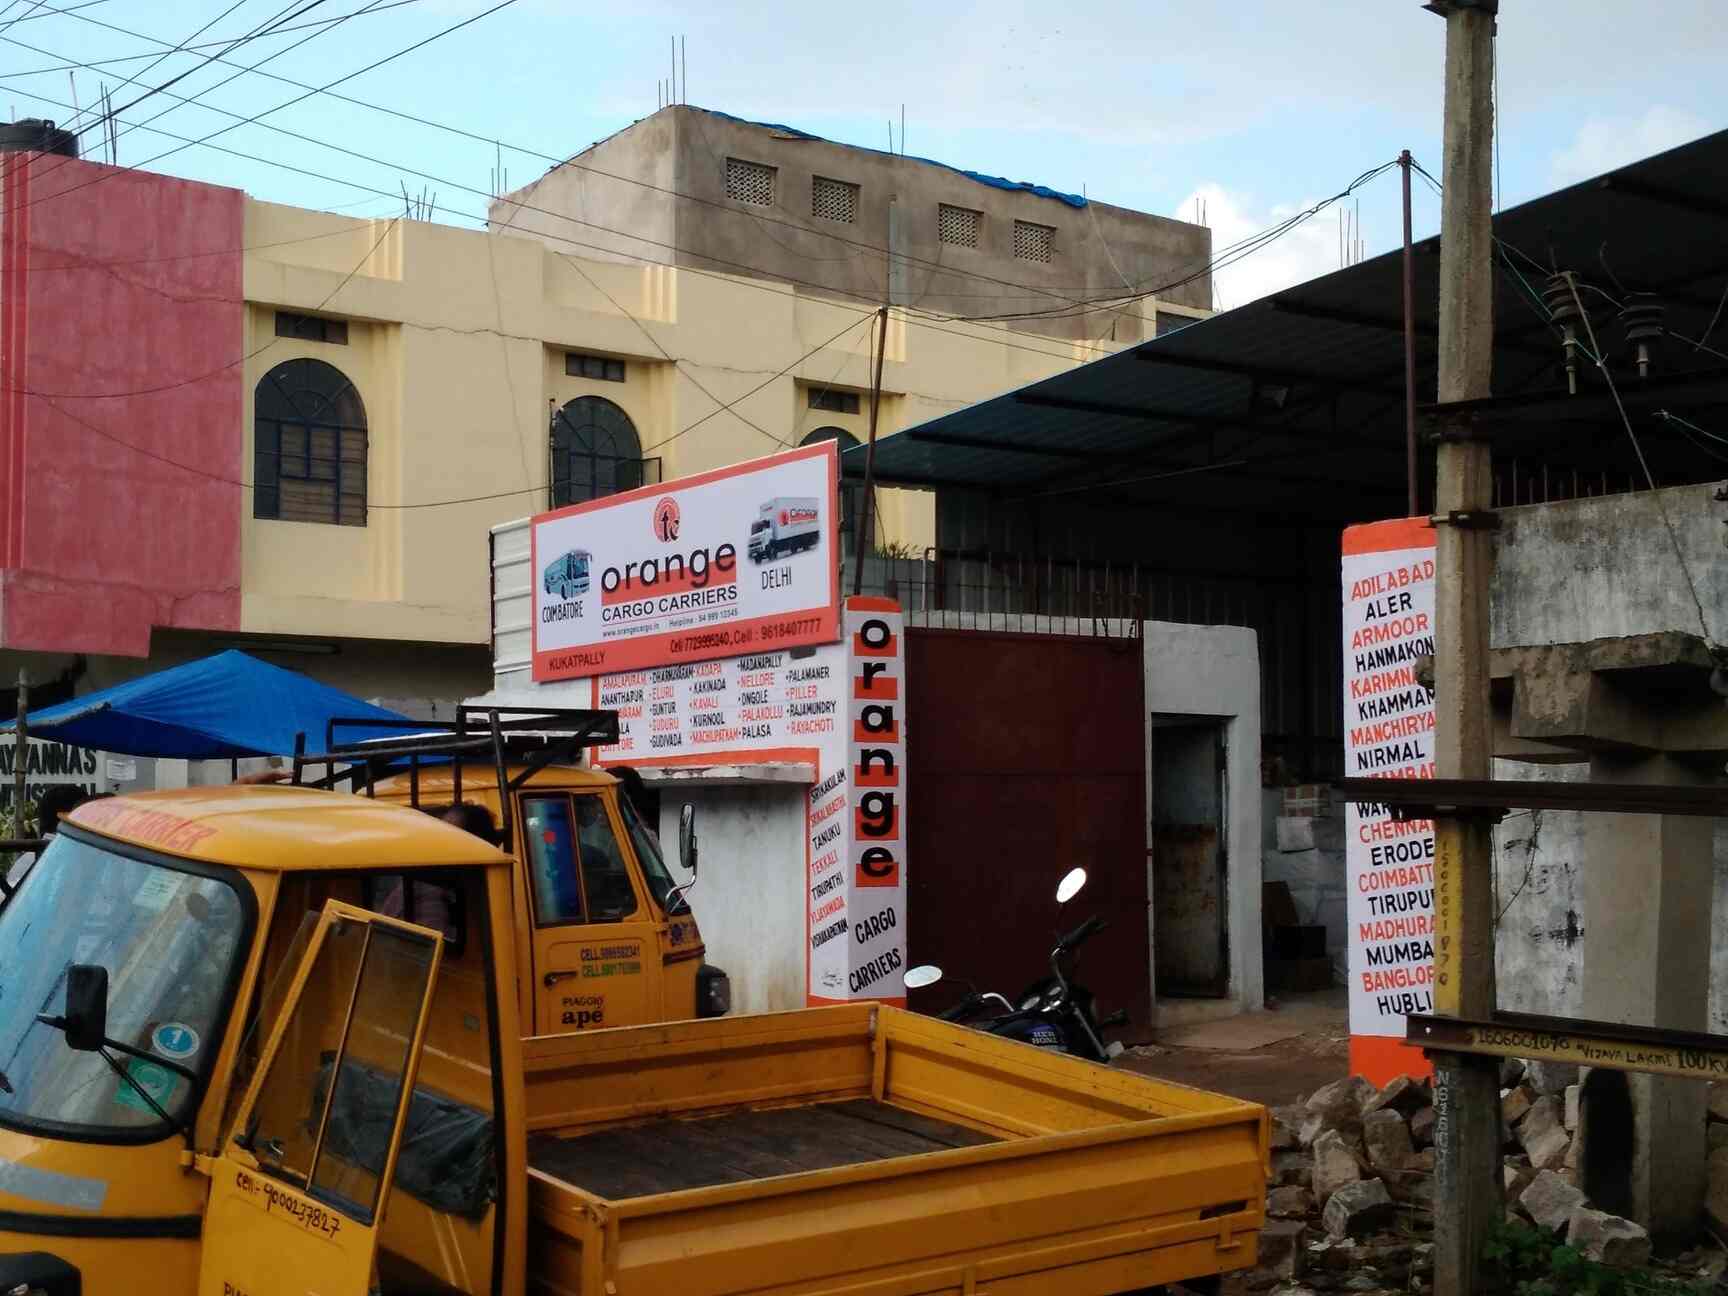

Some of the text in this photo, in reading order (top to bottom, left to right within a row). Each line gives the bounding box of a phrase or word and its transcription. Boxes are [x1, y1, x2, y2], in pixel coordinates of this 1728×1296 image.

[601, 542, 737, 593] orange
[761, 566, 792, 590] DELHI
[1351, 560, 1434, 601] ADILABAD
[542, 600, 584, 623] COIMBATORE
[602, 585, 737, 622] CARGO CARRIERS
[1365, 591, 1412, 621] ALER
[1352, 613, 1428, 649] ARMOOR
[549, 652, 605, 672] KUKATPALLY
[1355, 636, 1435, 672] HANMAKON
[693, 678, 726, 693] KAKINADA
[740, 671, 775, 687] NELLORE
[788, 666, 830, 682] PALAMANER
[601, 690, 644, 705] ANANTHAPUR
[652, 701, 677, 716] GUNTUR
[741, 690, 768, 705] ONGOLE
[692, 711, 725, 727] KURNOOL
[742, 724, 772, 740] PALASA
[1350, 711, 1436, 748] MANCHIRYA
[859, 618, 895, 878] orange
[1357, 740, 1425, 770] NIRMAL
[812, 822, 841, 850] TANUKU
[1371, 838, 1434, 866] ERODE
[1359, 862, 1435, 892] COIMBATT
[855, 907, 897, 945] CARGO
[1359, 914, 1436, 942] MADHURA
[1366, 941, 1434, 966] MUMBA
[849, 948, 902, 993] CARRIERS
[1377, 991, 1432, 1016] HUBLI
[562, 1009, 604, 1028] ape
